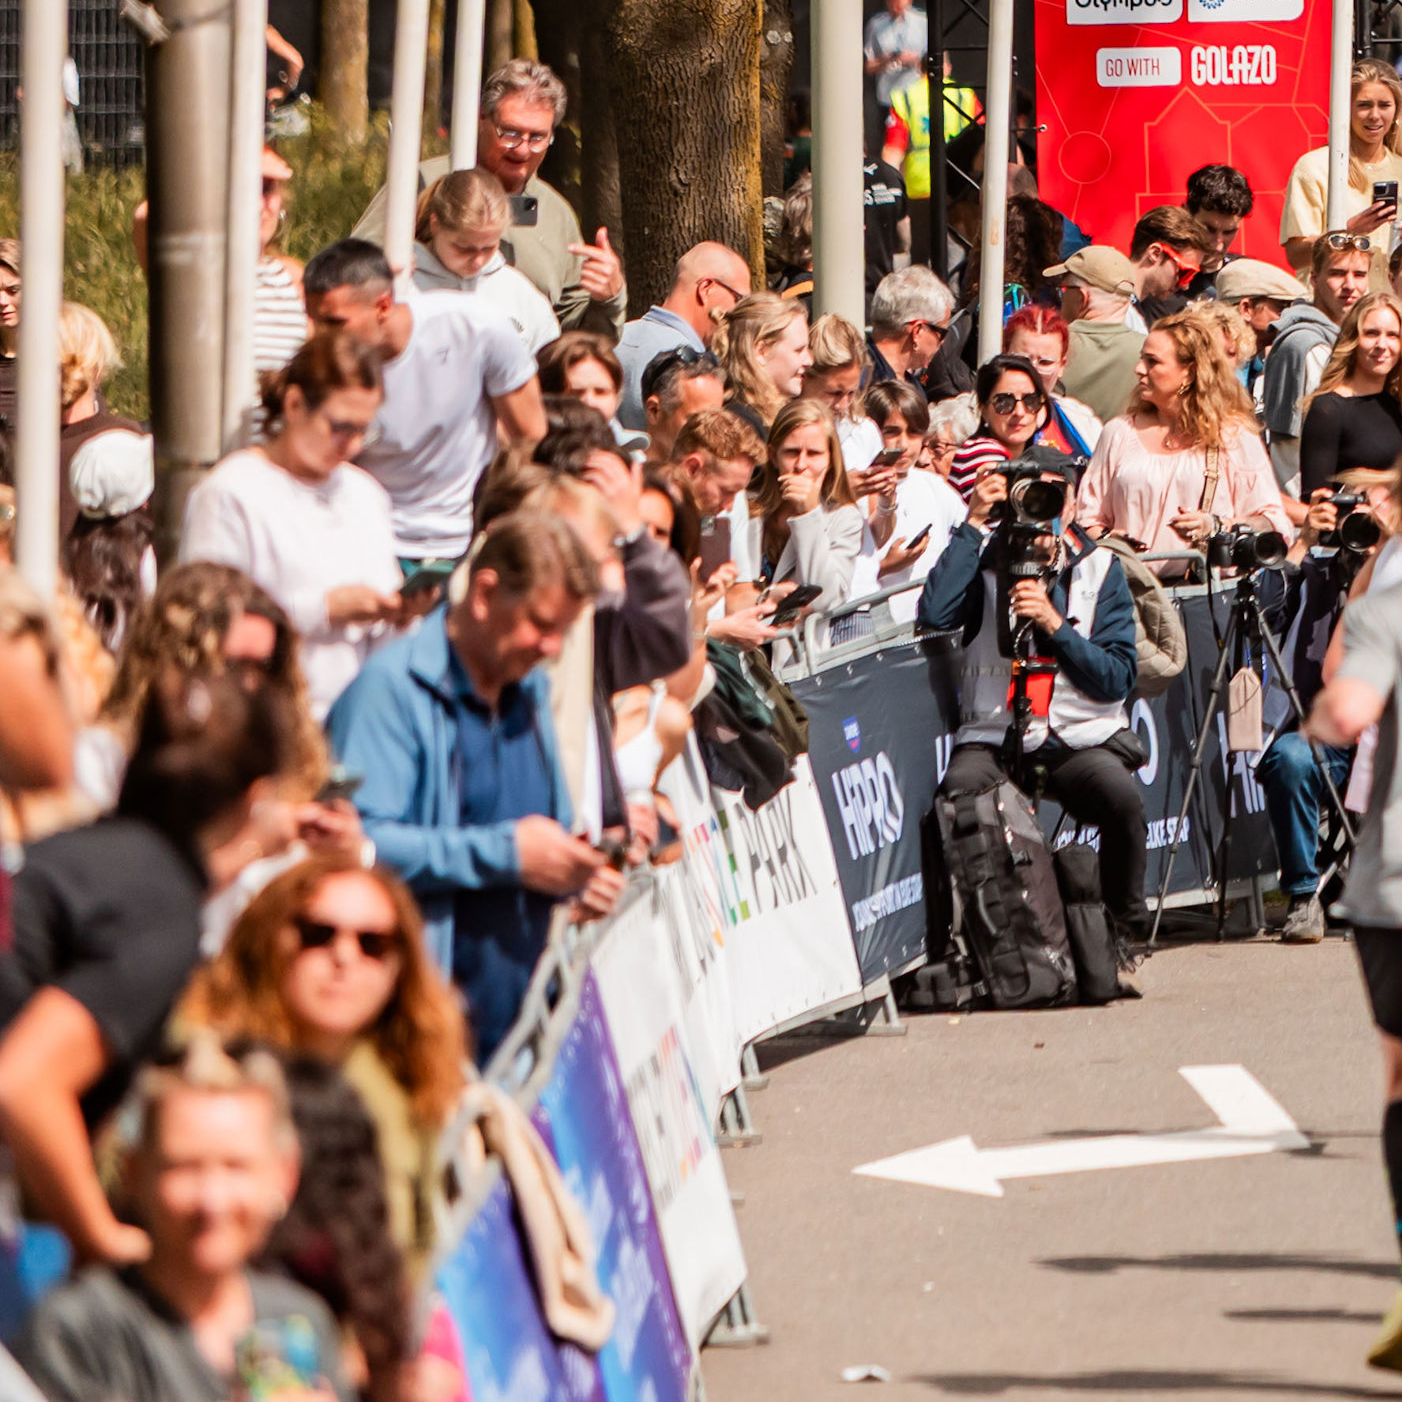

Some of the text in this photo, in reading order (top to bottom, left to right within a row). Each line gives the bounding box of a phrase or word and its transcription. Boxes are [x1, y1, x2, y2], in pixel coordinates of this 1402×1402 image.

[1105, 58, 1161, 77] GO WITH
[1191, 44, 1277, 86] GOLAZO
